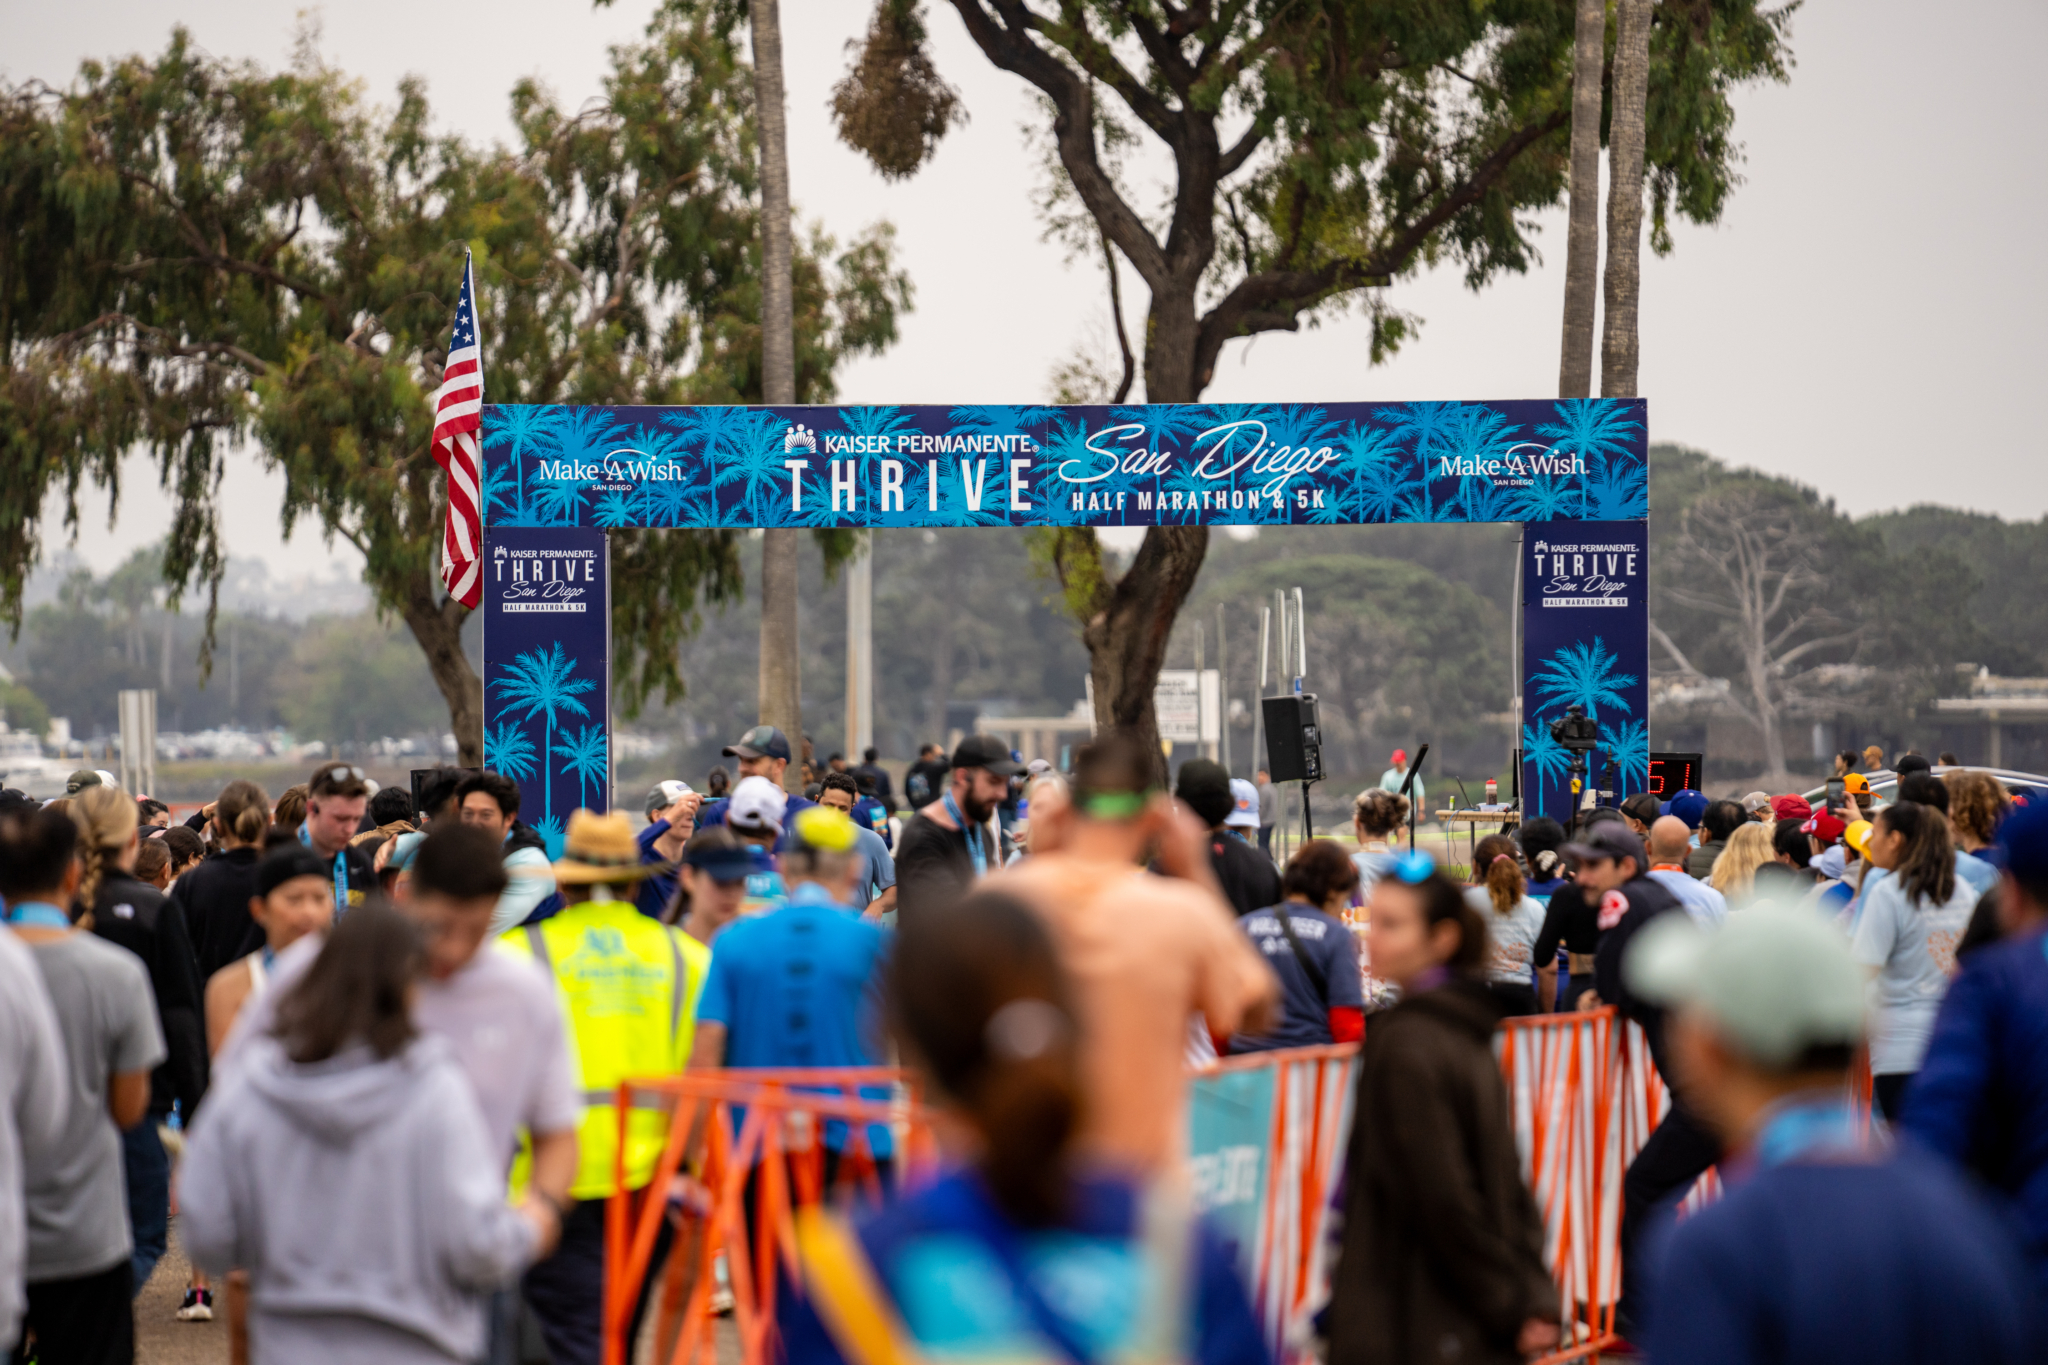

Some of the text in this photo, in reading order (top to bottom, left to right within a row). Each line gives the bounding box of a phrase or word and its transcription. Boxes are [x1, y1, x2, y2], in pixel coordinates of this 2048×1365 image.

[825, 435, 890, 453] KAISER
[1058, 420, 1341, 498] San Diego
[784, 459, 1032, 512] THRIVE
[1072, 489, 1325, 511] HALF MARATHON & 5K
[510, 550, 538, 558] KAISER
[1551, 544, 1579, 552] KAISER
[494, 560, 595, 581] THRIVE
[1534, 554, 1636, 576] THRIVE
[502, 580, 586, 603] San Diego
[1542, 574, 1628, 598] San Diego
[1565, 598, 1606, 606] MARATHON
